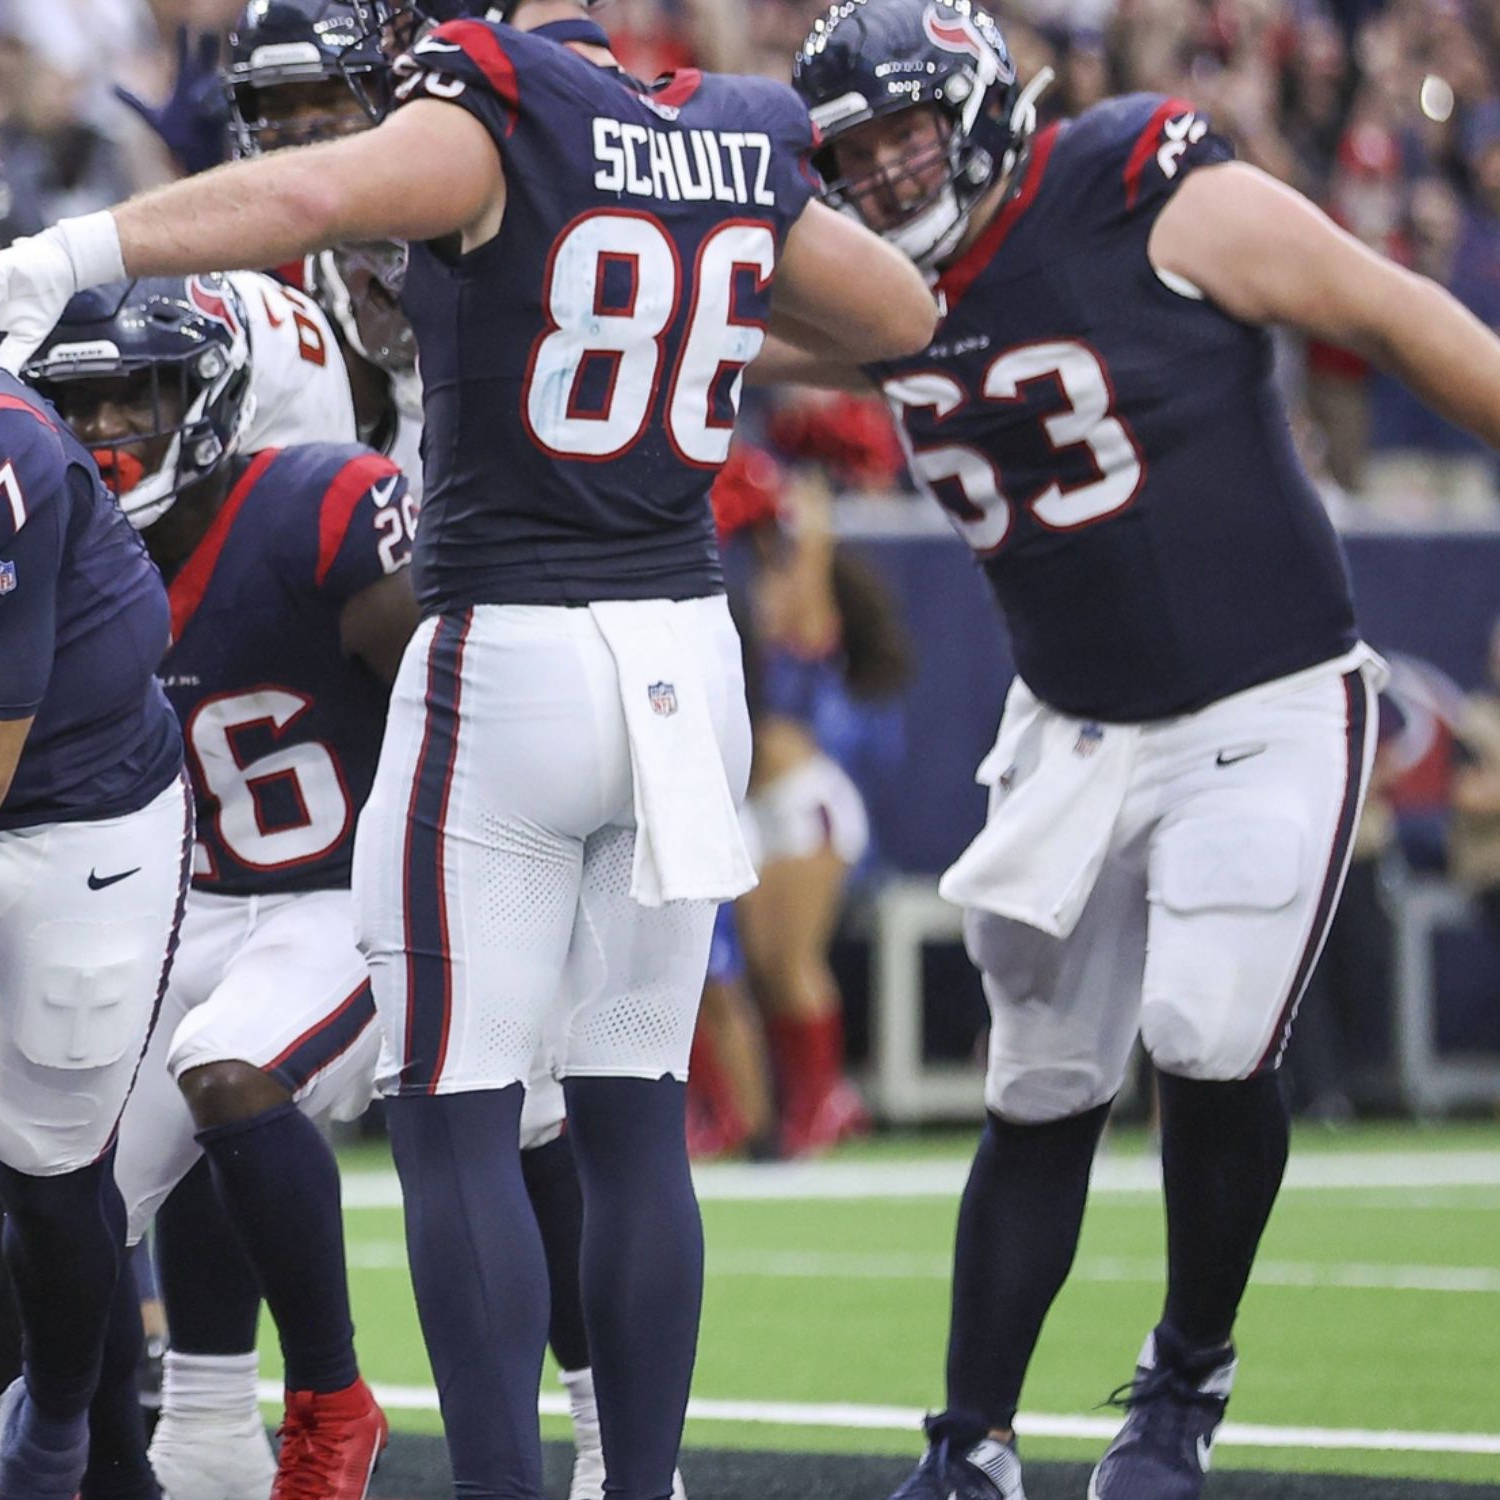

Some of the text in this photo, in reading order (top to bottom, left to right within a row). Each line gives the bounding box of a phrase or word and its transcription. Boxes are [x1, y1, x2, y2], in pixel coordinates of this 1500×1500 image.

[593, 117, 775, 206] SCHULTZ
[522, 208, 776, 472] 86
[881, 338, 1145, 556] 63
